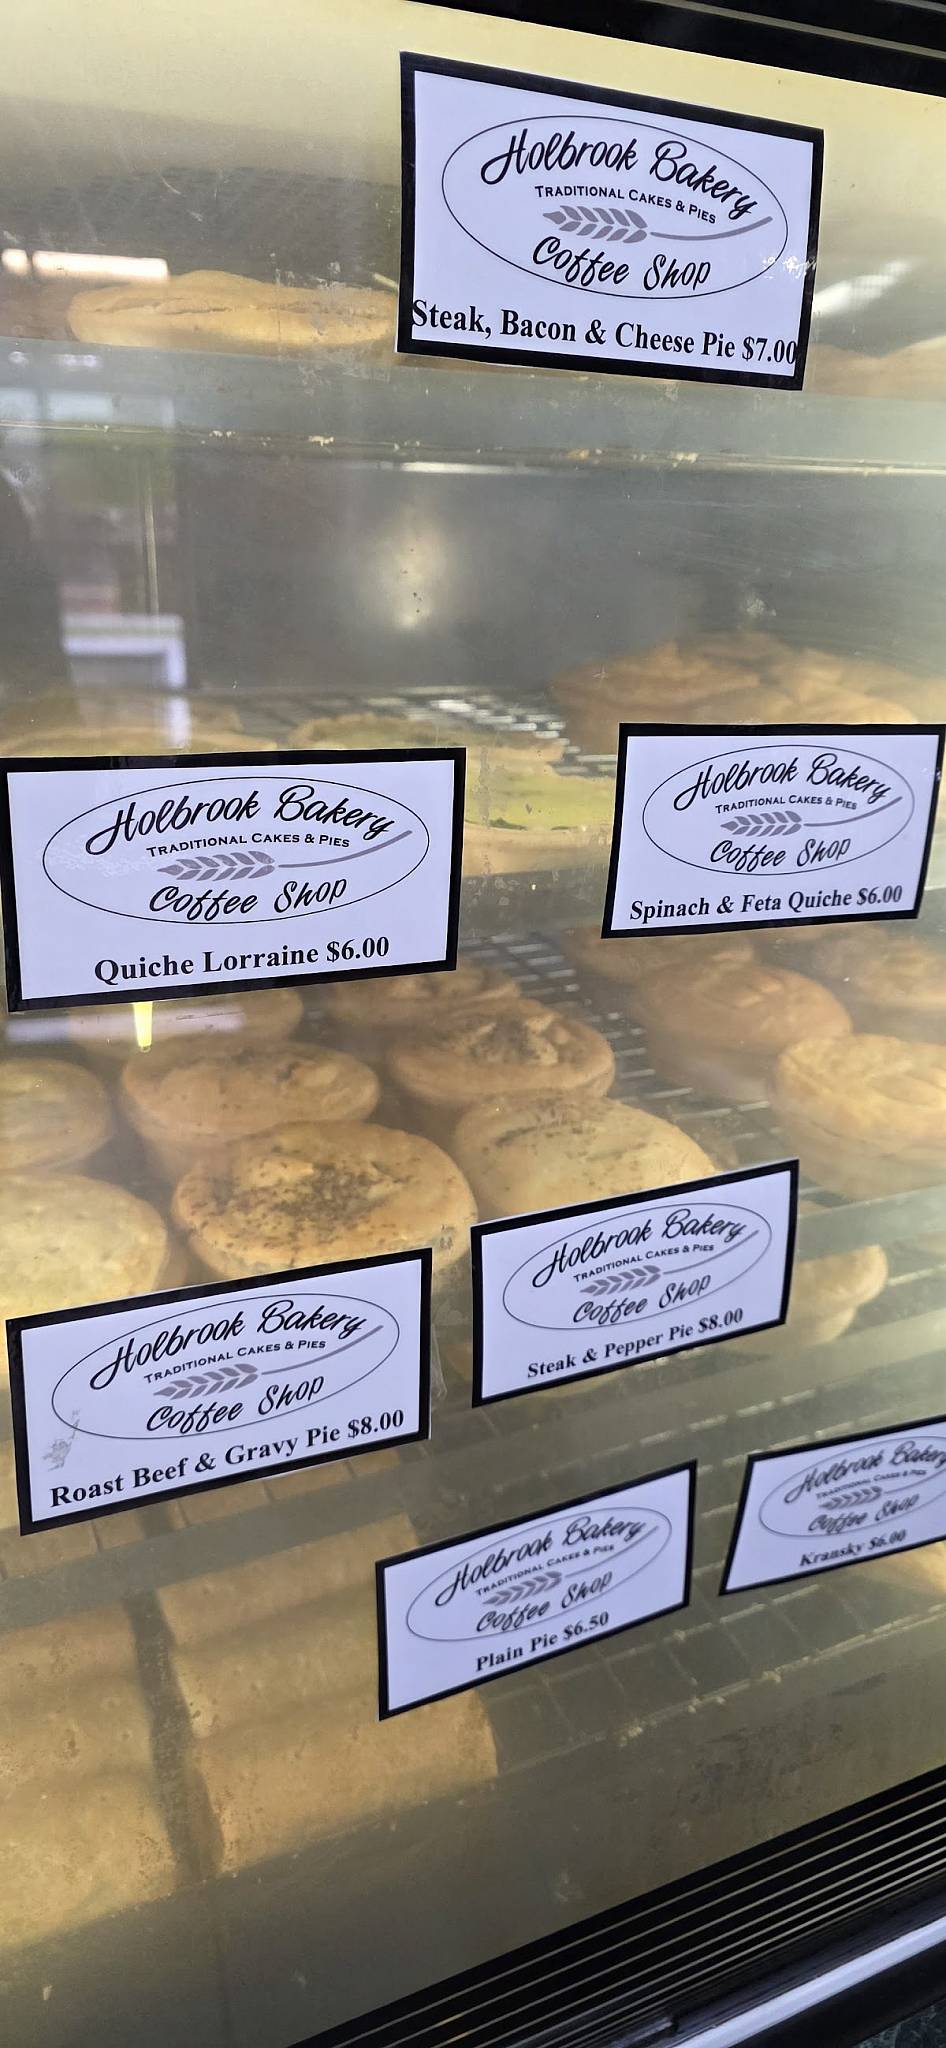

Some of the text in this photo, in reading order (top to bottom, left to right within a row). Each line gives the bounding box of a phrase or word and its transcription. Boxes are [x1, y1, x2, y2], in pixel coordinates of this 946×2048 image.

[480, 128, 758, 220] Holbrook Bakery
[535, 185, 717, 224] TRADITIONAL CAKES & PIES
[533, 236, 711, 291] Coffee Shop
[411, 299, 798, 365] Steak, Bacon & Cheese Pie $7.00
[673, 753, 892, 811] Holbrook Bakery
[715, 795, 857, 814] TRADITIONAL CAKES & PIES
[85, 785, 396, 855] Holbrook Bakery
[146, 832, 350, 858] TRADITIONAL CAKES & PIES
[710, 838, 851, 872] Coffee Shop
[149, 878, 347, 921] Coffee Shop
[629, 885, 903, 924] Spinach & Feta Quiche $6.00
[94, 936, 390, 986] Quiche Lorraine $6.00
[532, 1208, 747, 1288] Holbrook Bakery
[573, 1243, 715, 1283] TRADITIONAL CAKES & PIES
[572, 1274, 711, 1325] Coffee Shop
[89, 1299, 368, 1390] Holbrook Bakery
[144, 1338, 326, 1384] TRADITIONAL CAKES & PIES
[527, 1307, 744, 1378] Steak & Pepper Pie $8.00
[146, 1375, 325, 1433] Coffee Shop
[50, 1408, 404, 1508] Roast Beef & Gravy Pie $8.00
[784, 1449, 885, 1504] Holbrook
[808, 1494, 920, 1534] Coffee Shop
[435, 1516, 647, 1606] Holbrook Bakery
[799, 1529, 906, 1566] Kransky $6.00
[476, 1571, 613, 1633] Coffee Shop
[475, 1610, 610, 1672] Plain Pie $6.50
